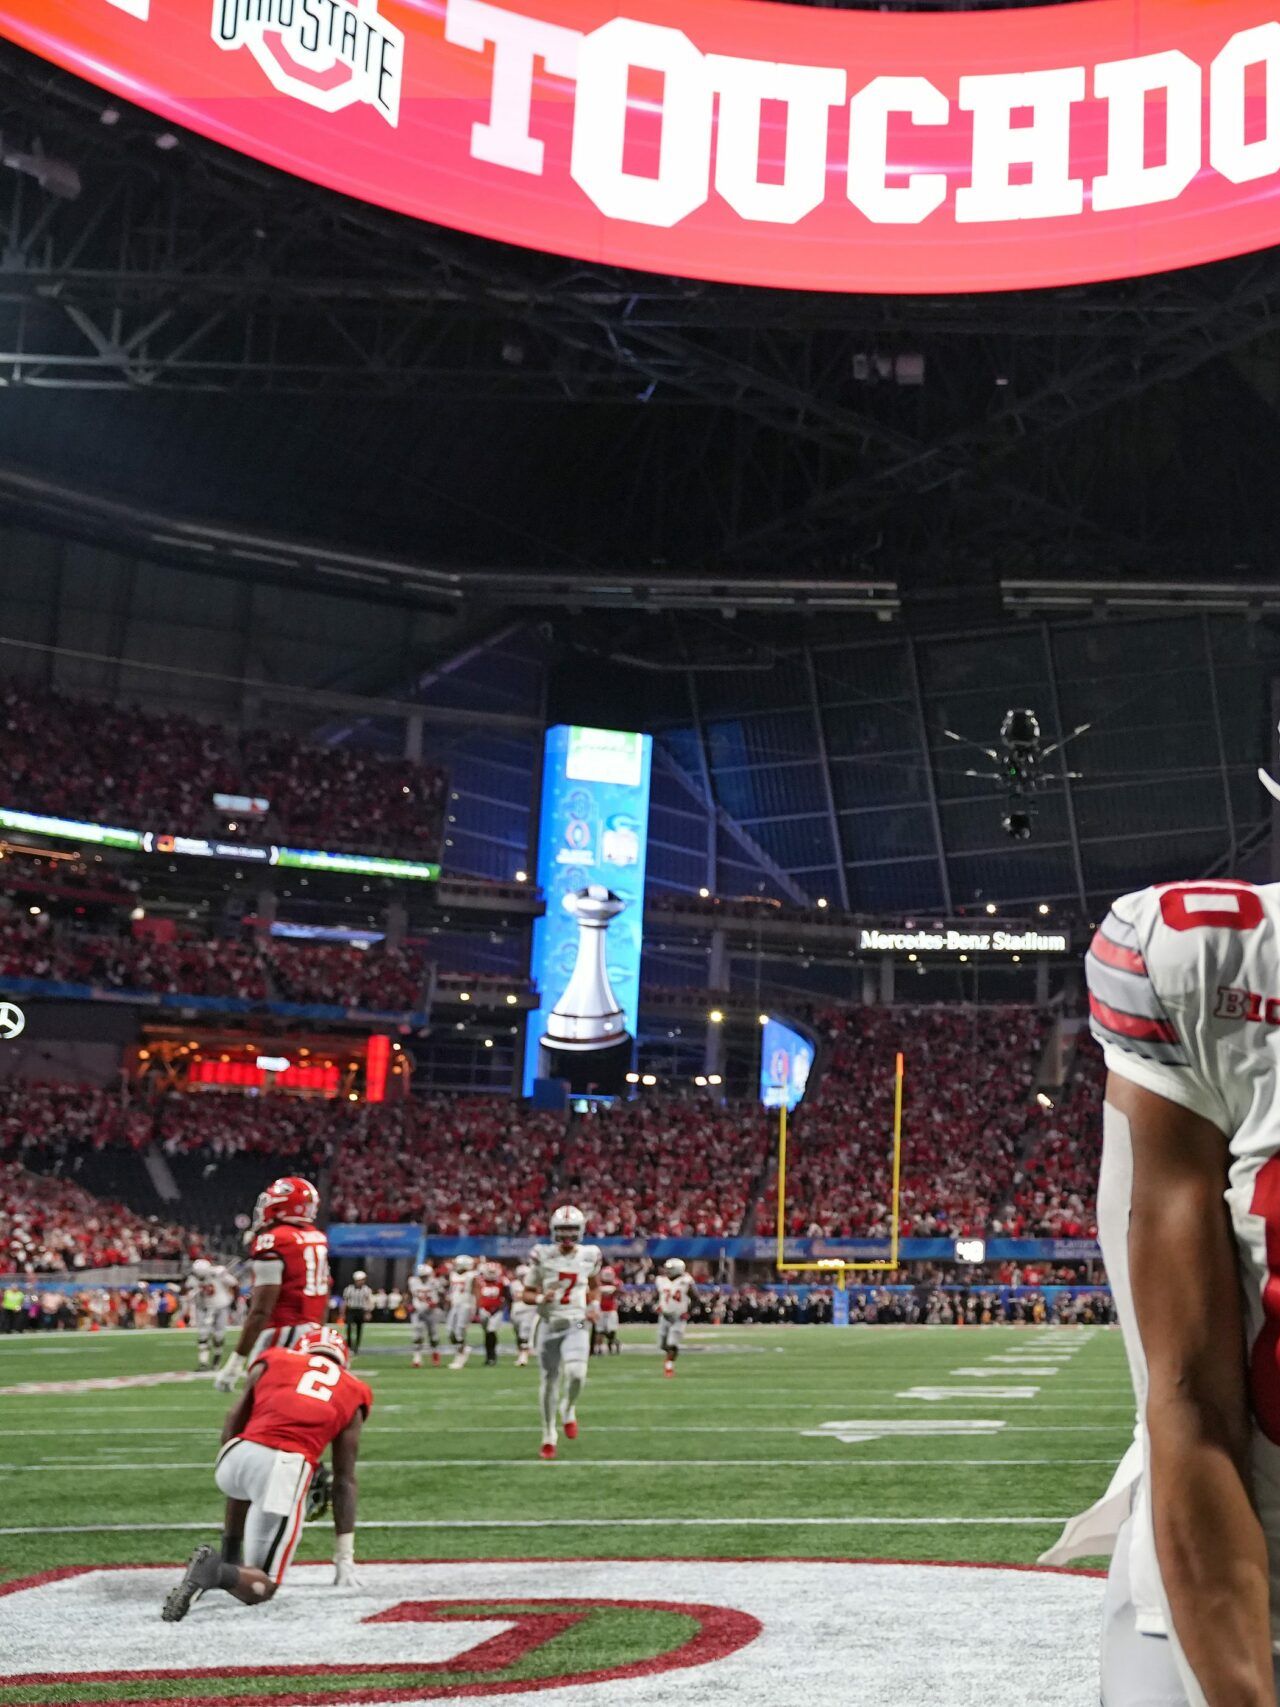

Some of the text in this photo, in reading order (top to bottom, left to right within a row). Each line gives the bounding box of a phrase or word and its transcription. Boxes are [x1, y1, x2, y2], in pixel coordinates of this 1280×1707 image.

[860, 930, 1066, 950] Mercedes-Benz Stadium
[558, 1272, 578, 1305] 7
[296, 1355, 341, 1402] 2
